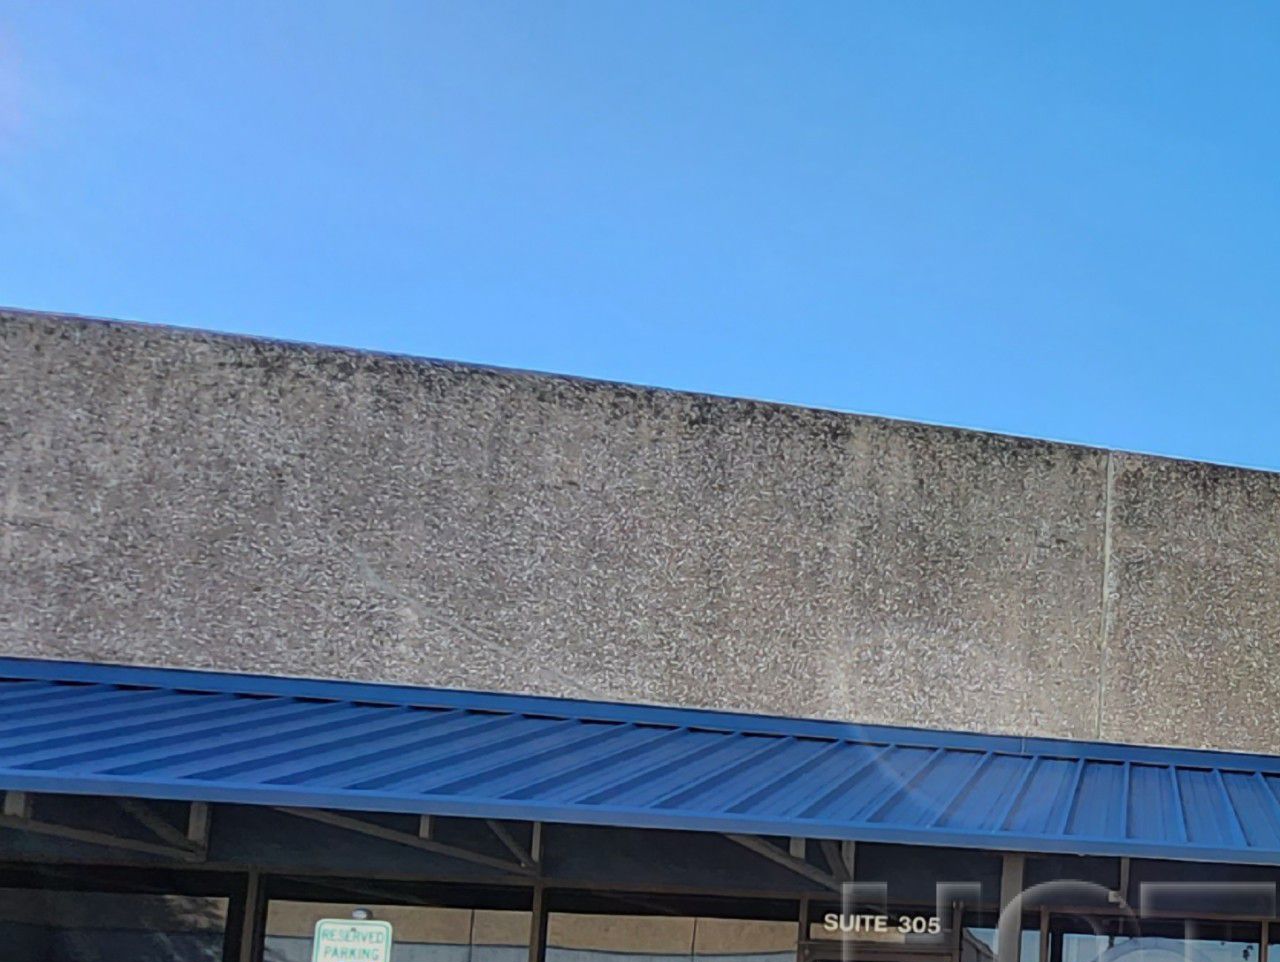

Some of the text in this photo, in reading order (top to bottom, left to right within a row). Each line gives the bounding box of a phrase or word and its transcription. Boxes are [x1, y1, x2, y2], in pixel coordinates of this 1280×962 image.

[823, 913, 941, 934] SUITE 305
[321, 928, 384, 943] RESERVED
[323, 946, 379, 960] PARKING
